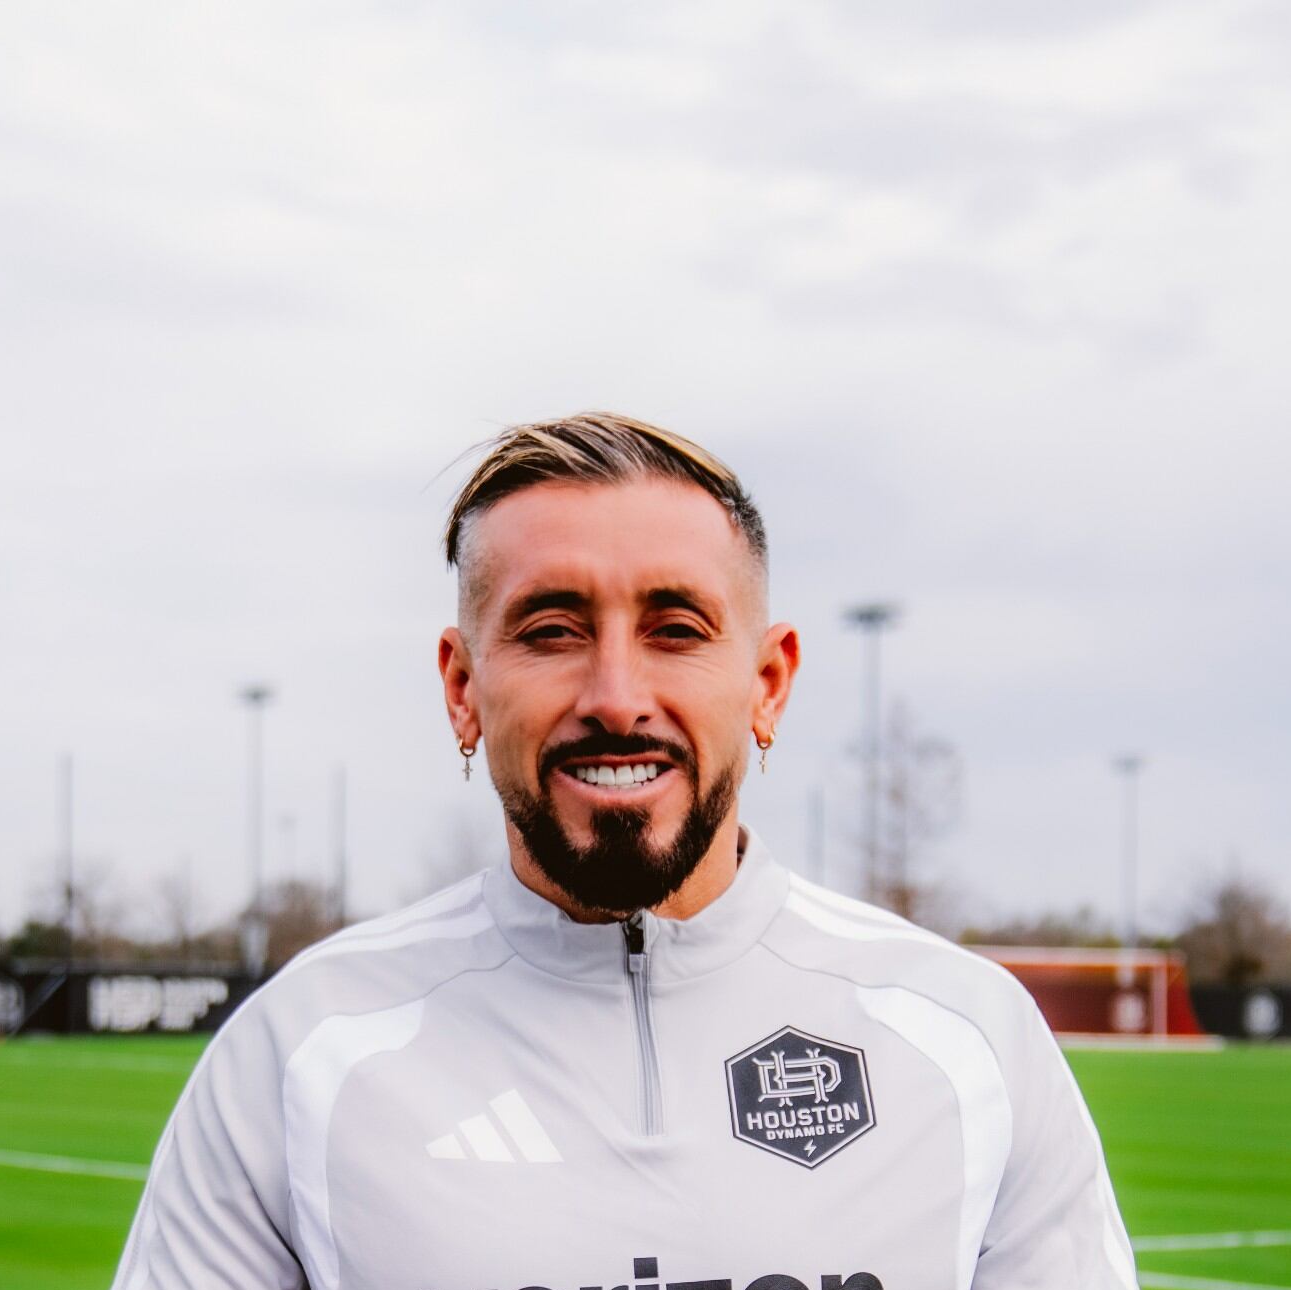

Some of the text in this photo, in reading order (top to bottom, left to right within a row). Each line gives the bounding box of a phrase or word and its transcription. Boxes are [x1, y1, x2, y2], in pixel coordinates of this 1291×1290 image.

[746, 1102, 860, 1130] HOUSTON
[766, 1123, 845, 1140] DYNAMO FC
